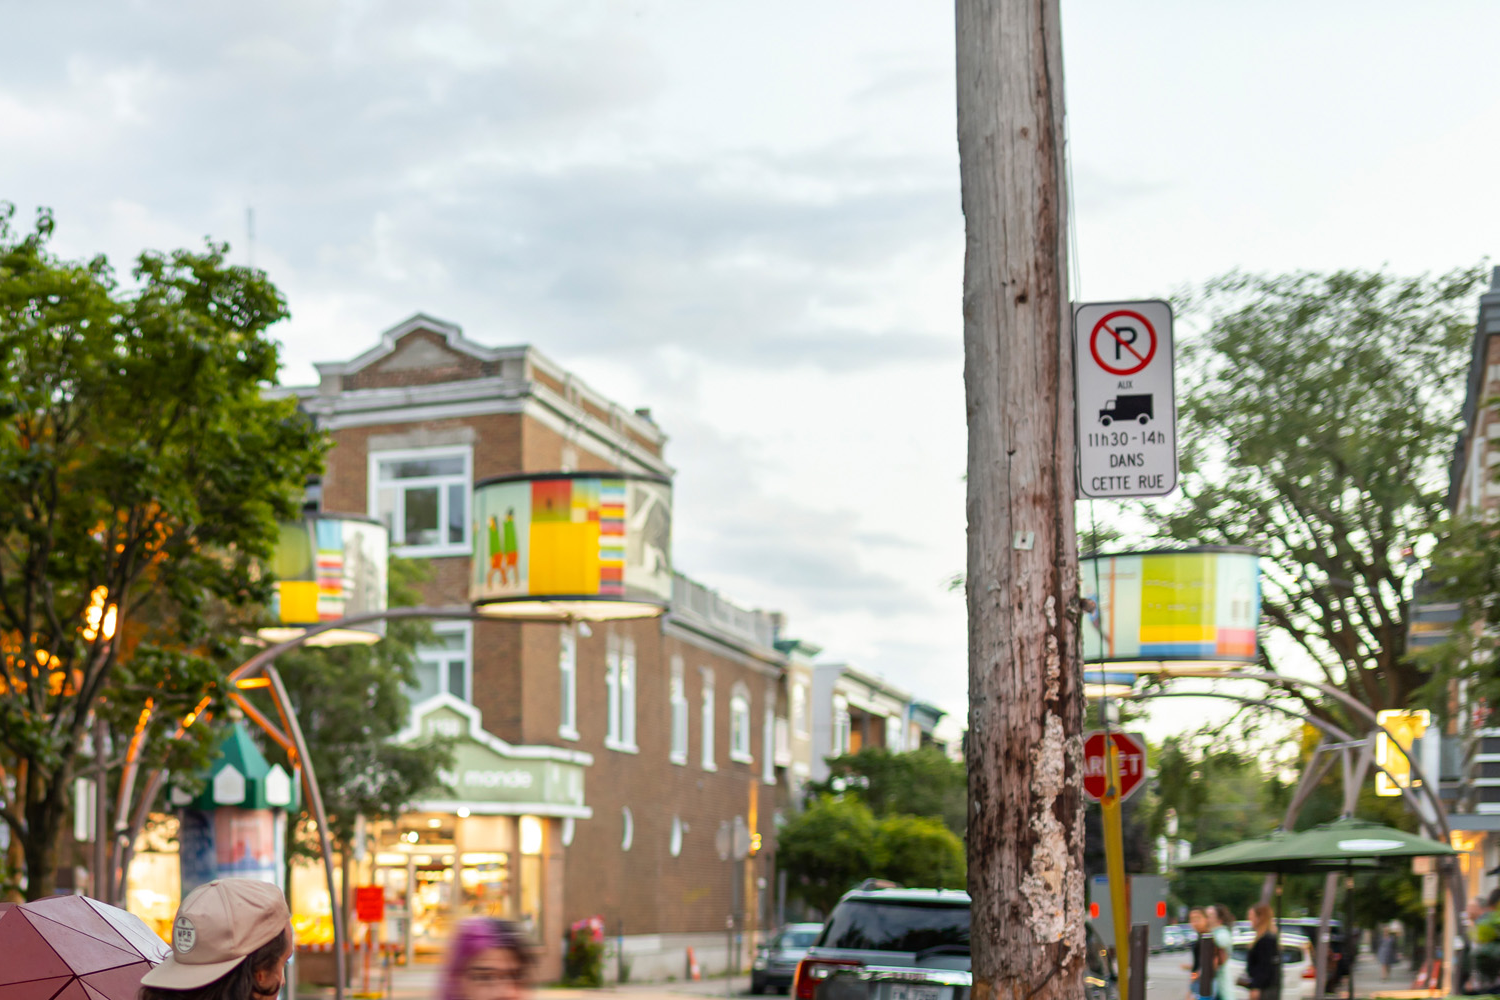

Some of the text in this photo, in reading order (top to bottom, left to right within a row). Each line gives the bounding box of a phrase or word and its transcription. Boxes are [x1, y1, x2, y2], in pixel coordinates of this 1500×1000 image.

[1117, 380, 1133, 389] AUX
[1110, 453, 1144, 468] DANS
[1092, 474, 1164, 491] CETTE RUE
[465, 768, 532, 788] monde
